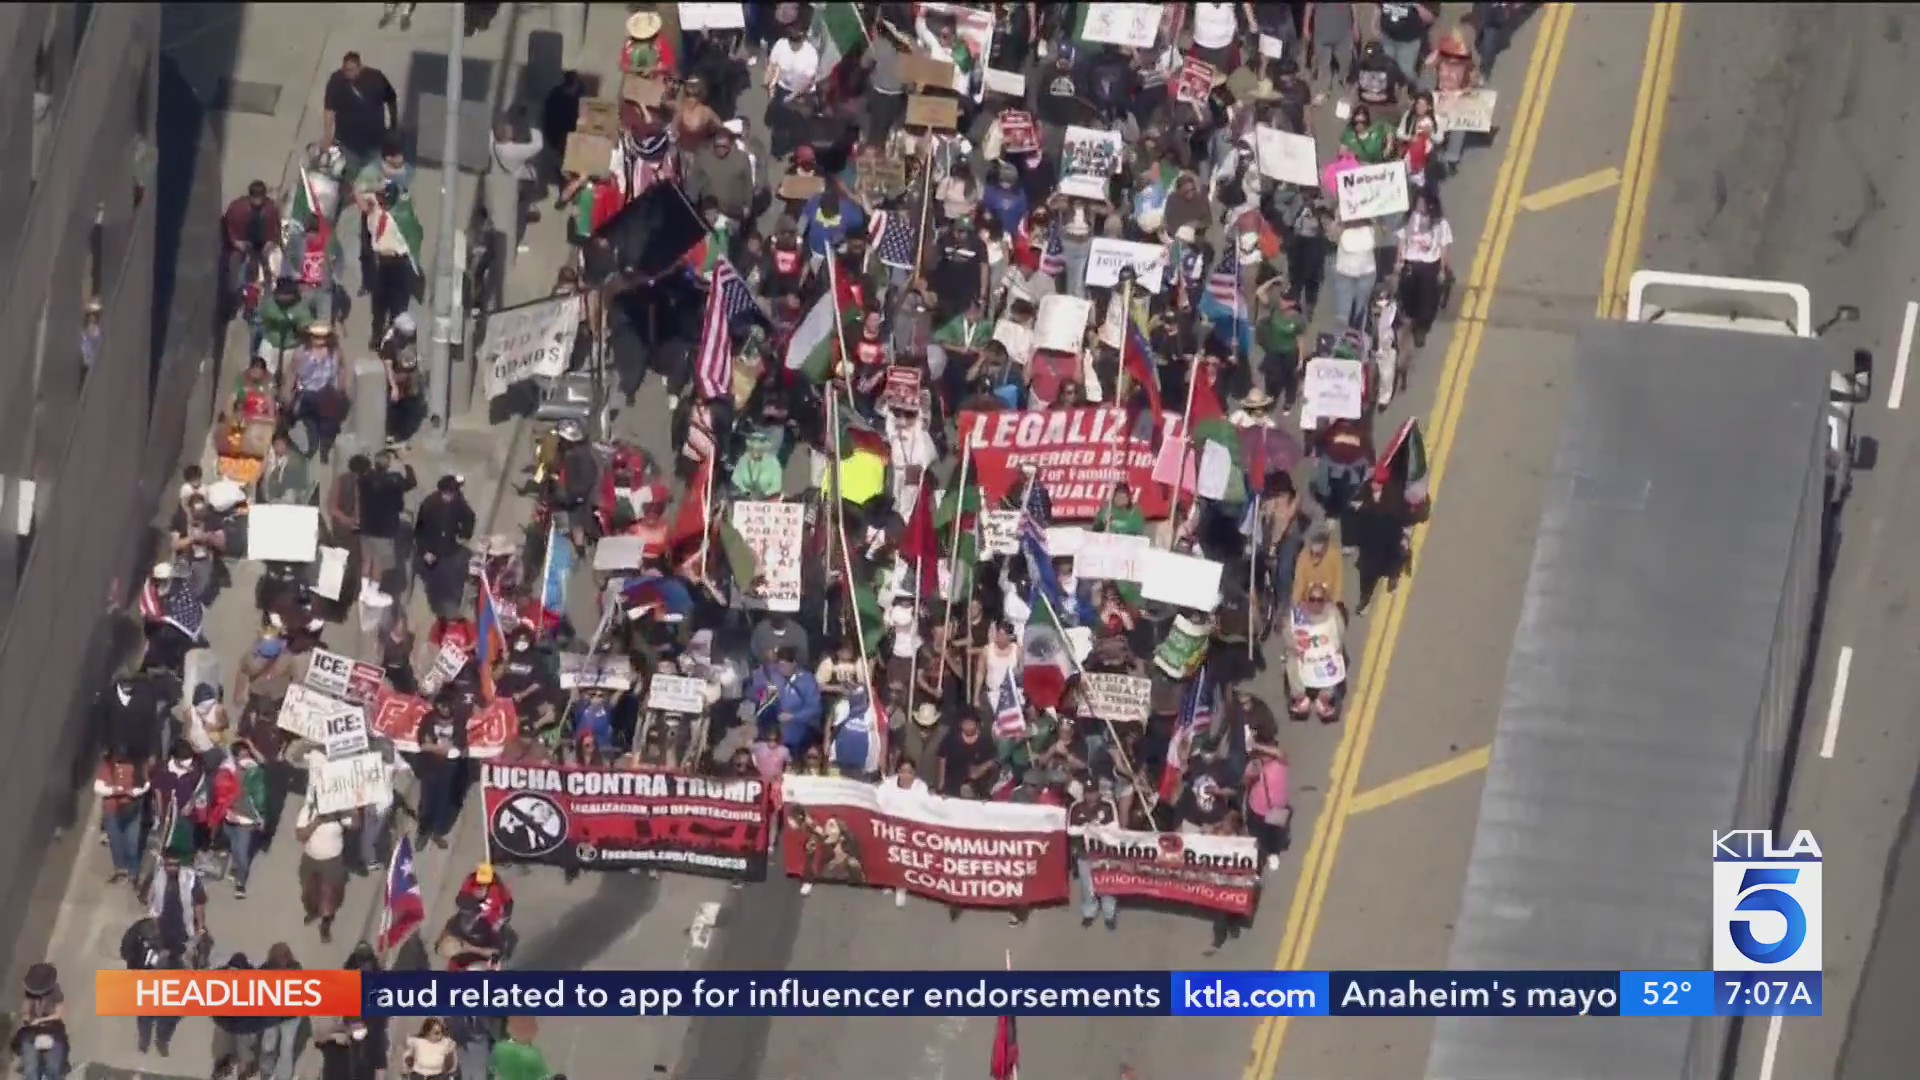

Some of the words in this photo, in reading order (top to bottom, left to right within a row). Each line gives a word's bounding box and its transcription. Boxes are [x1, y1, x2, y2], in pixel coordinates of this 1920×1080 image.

[314, 654, 349, 677] ICE:
[326, 714, 362, 735] ICE:
[481, 763, 562, 793] LUCHA
[567, 771, 668, 797] CONTRA
[675, 775, 763, 803] TRUMP
[870, 818, 905, 844] THE
[912, 830, 1049, 859] COMMUNITY
[887, 845, 1037, 877] SELF-DEFENSE
[1183, 848, 1253, 870] Barrio
[904, 869, 1023, 898] COALITION
